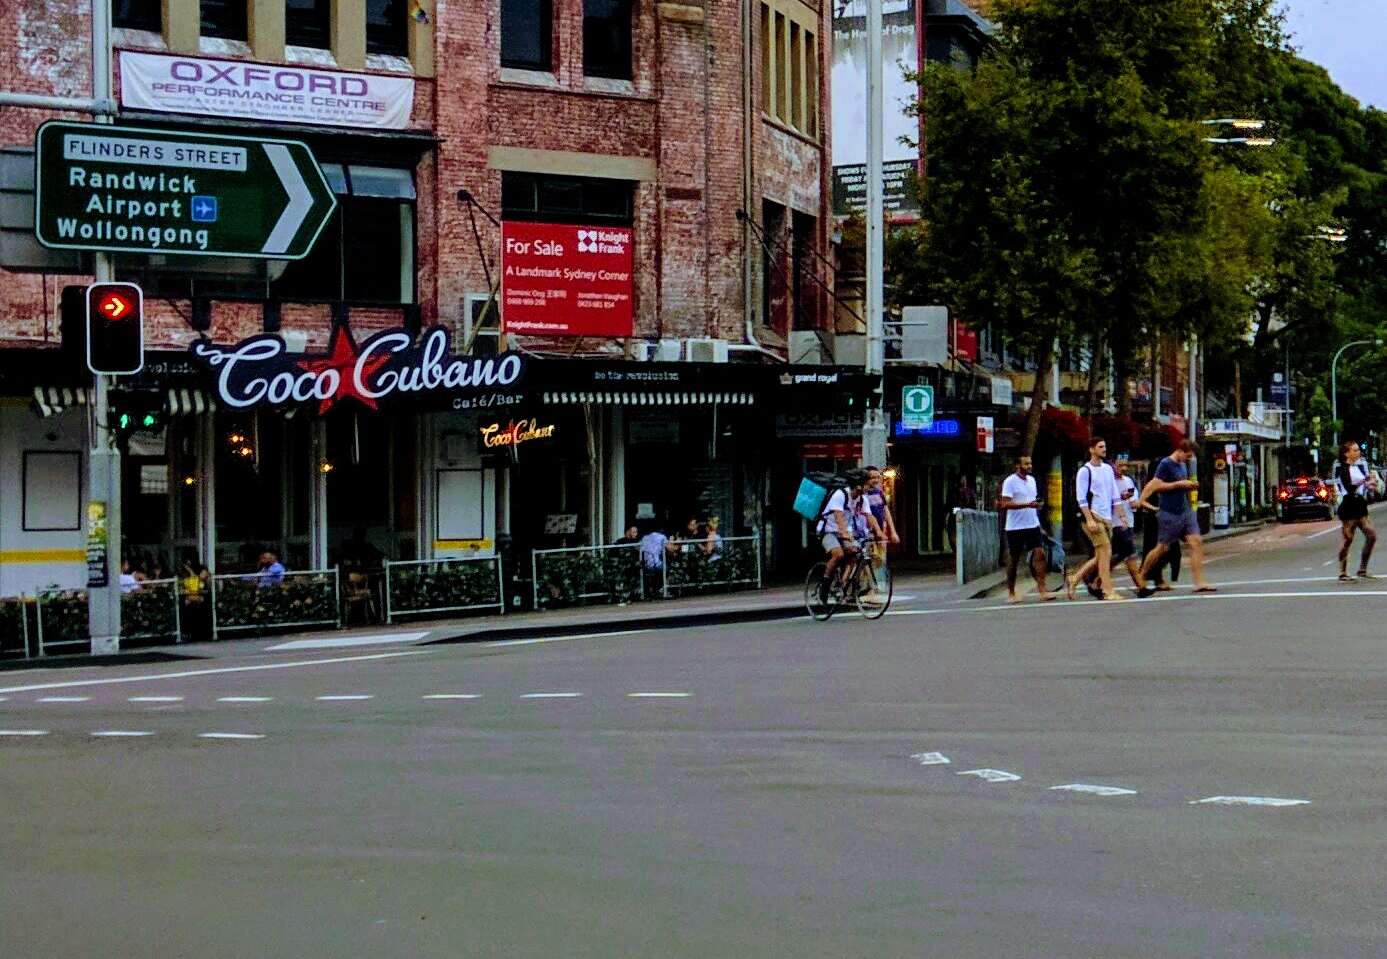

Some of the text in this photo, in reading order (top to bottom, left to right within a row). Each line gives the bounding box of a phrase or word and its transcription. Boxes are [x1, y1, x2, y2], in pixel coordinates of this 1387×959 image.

[170, 61, 369, 97] OXFORD
[151, 82, 386, 112] PERFORMANCE CENTRE
[70, 140, 241, 166] FLINDERS STREET
[69, 166, 196, 194] Randwick
[86, 194, 182, 219] Airport
[56, 217, 208, 250] Wollongong
[598, 231, 629, 243] Knight
[506, 238, 564, 257] For Sale
[598, 243, 625, 254] Frank
[506, 265, 629, 282] A Landmark Sydney Corner
[196, 330, 521, 408] Coco Cubano
